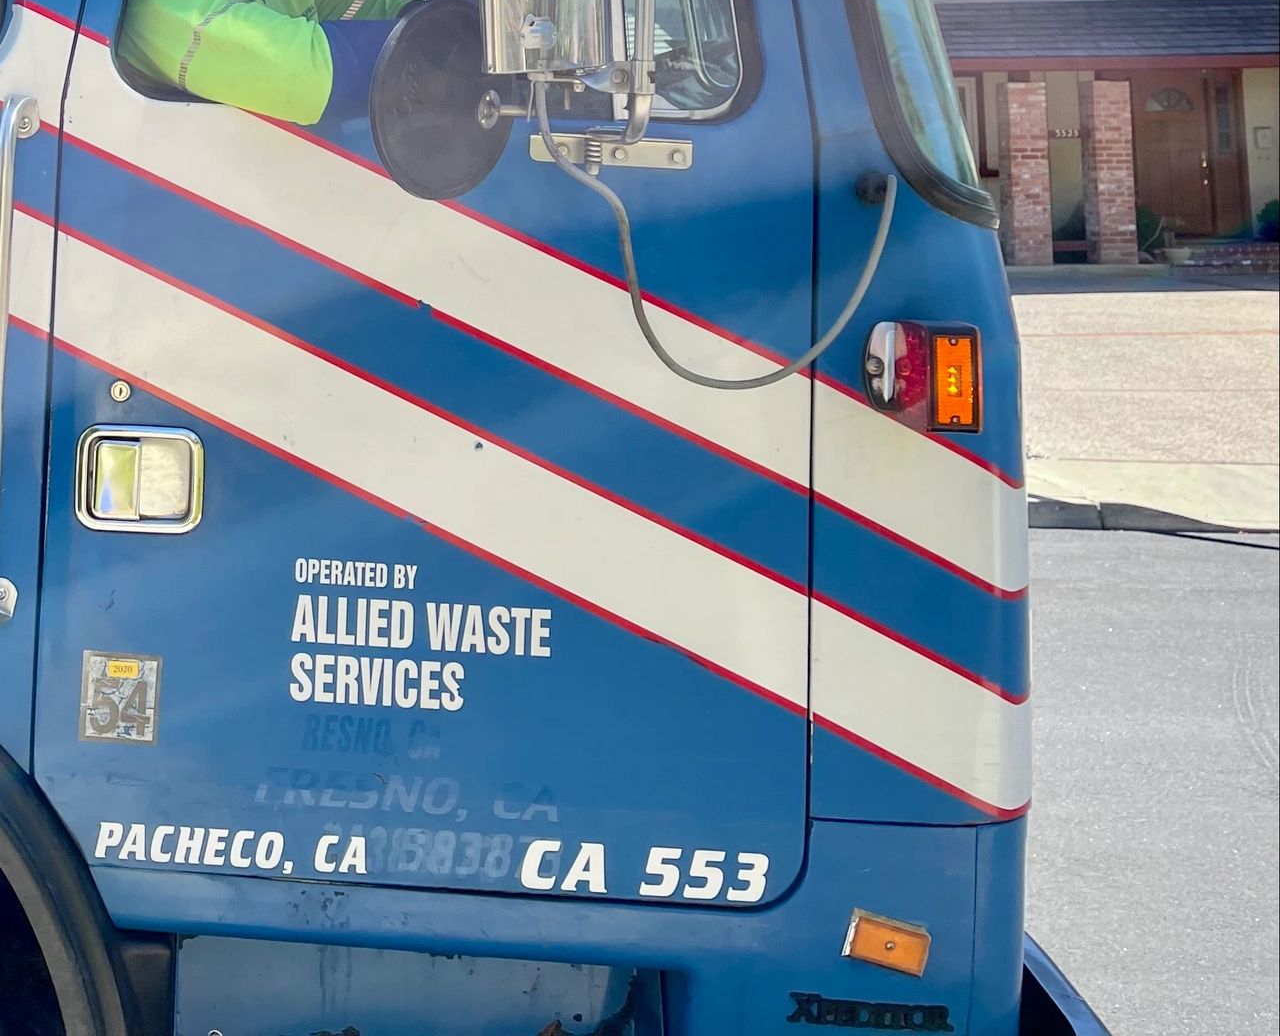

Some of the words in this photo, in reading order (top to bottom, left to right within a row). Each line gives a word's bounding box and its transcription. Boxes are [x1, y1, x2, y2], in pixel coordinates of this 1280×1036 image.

[294, 557, 388, 588] OPERATED
[393, 564, 417, 589] BY
[291, 594, 414, 649] ALLIED
[426, 602, 552, 657] WASTE
[112, 665, 133, 674] 2020
[289, 652, 465, 711] SERVICES
[89, 678, 151, 737] 54
[94, 821, 295, 875] PACHECO,
[314, 834, 368, 875] CA
[520, 839, 608, 894] CA
[638, 846, 770, 903] 553
